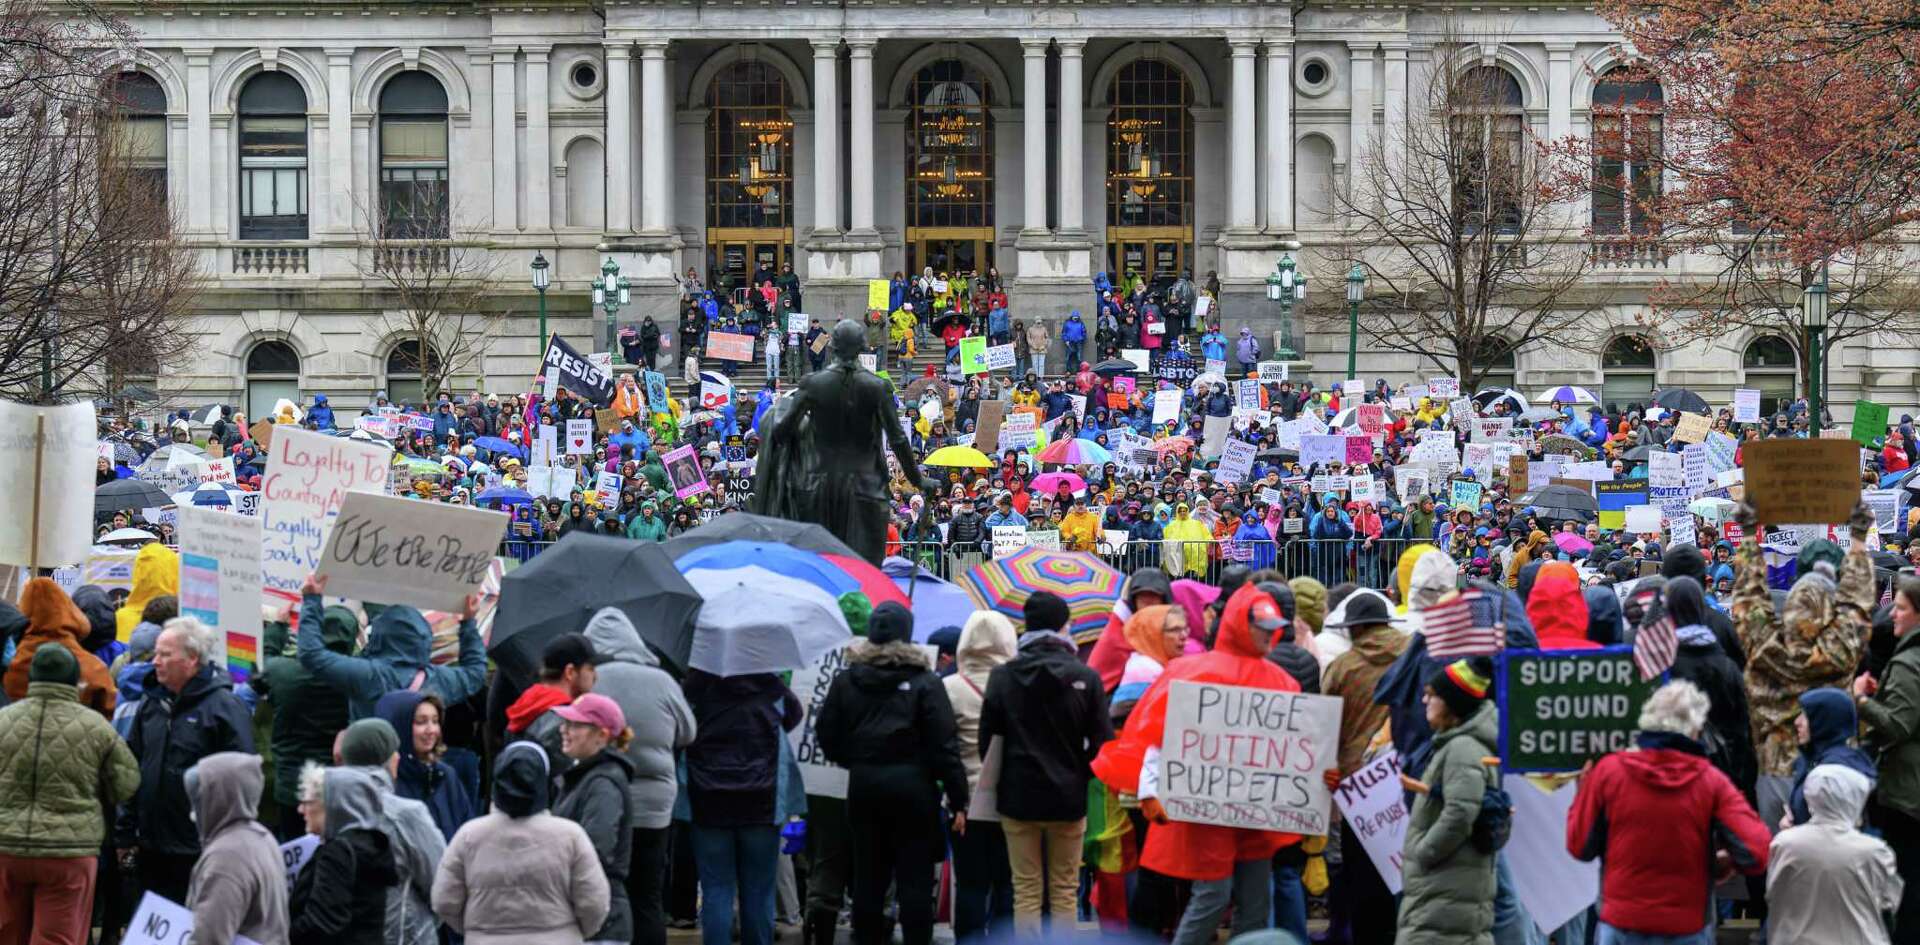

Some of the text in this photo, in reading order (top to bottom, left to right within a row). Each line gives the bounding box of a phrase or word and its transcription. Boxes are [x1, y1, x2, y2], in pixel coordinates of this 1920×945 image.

[1481, 422, 1502, 431] HANDS
[208, 463, 224, 471] WE
[282, 438, 385, 488] Loyalty To
[265, 472, 328, 519] Country
[729, 479, 750, 489] NO
[1454, 482, 1479, 493] HANDS
[1650, 486, 1691, 497] PROTECT
[263, 508, 322, 550] Loyalty
[332, 514, 386, 568] We
[396, 536, 431, 569] the
[1768, 531, 1794, 544] REJECT
[1520, 661, 1645, 686] SUPPOR
[1198, 686, 1309, 732] PURGE
[1536, 695, 1629, 719] SOUND
[1181, 729, 1314, 773] PUTIN'S
[1520, 731, 1641, 753] SCIENCE
[1167, 761, 1310, 808] PUPPETS
[144, 911, 170, 941] NO
